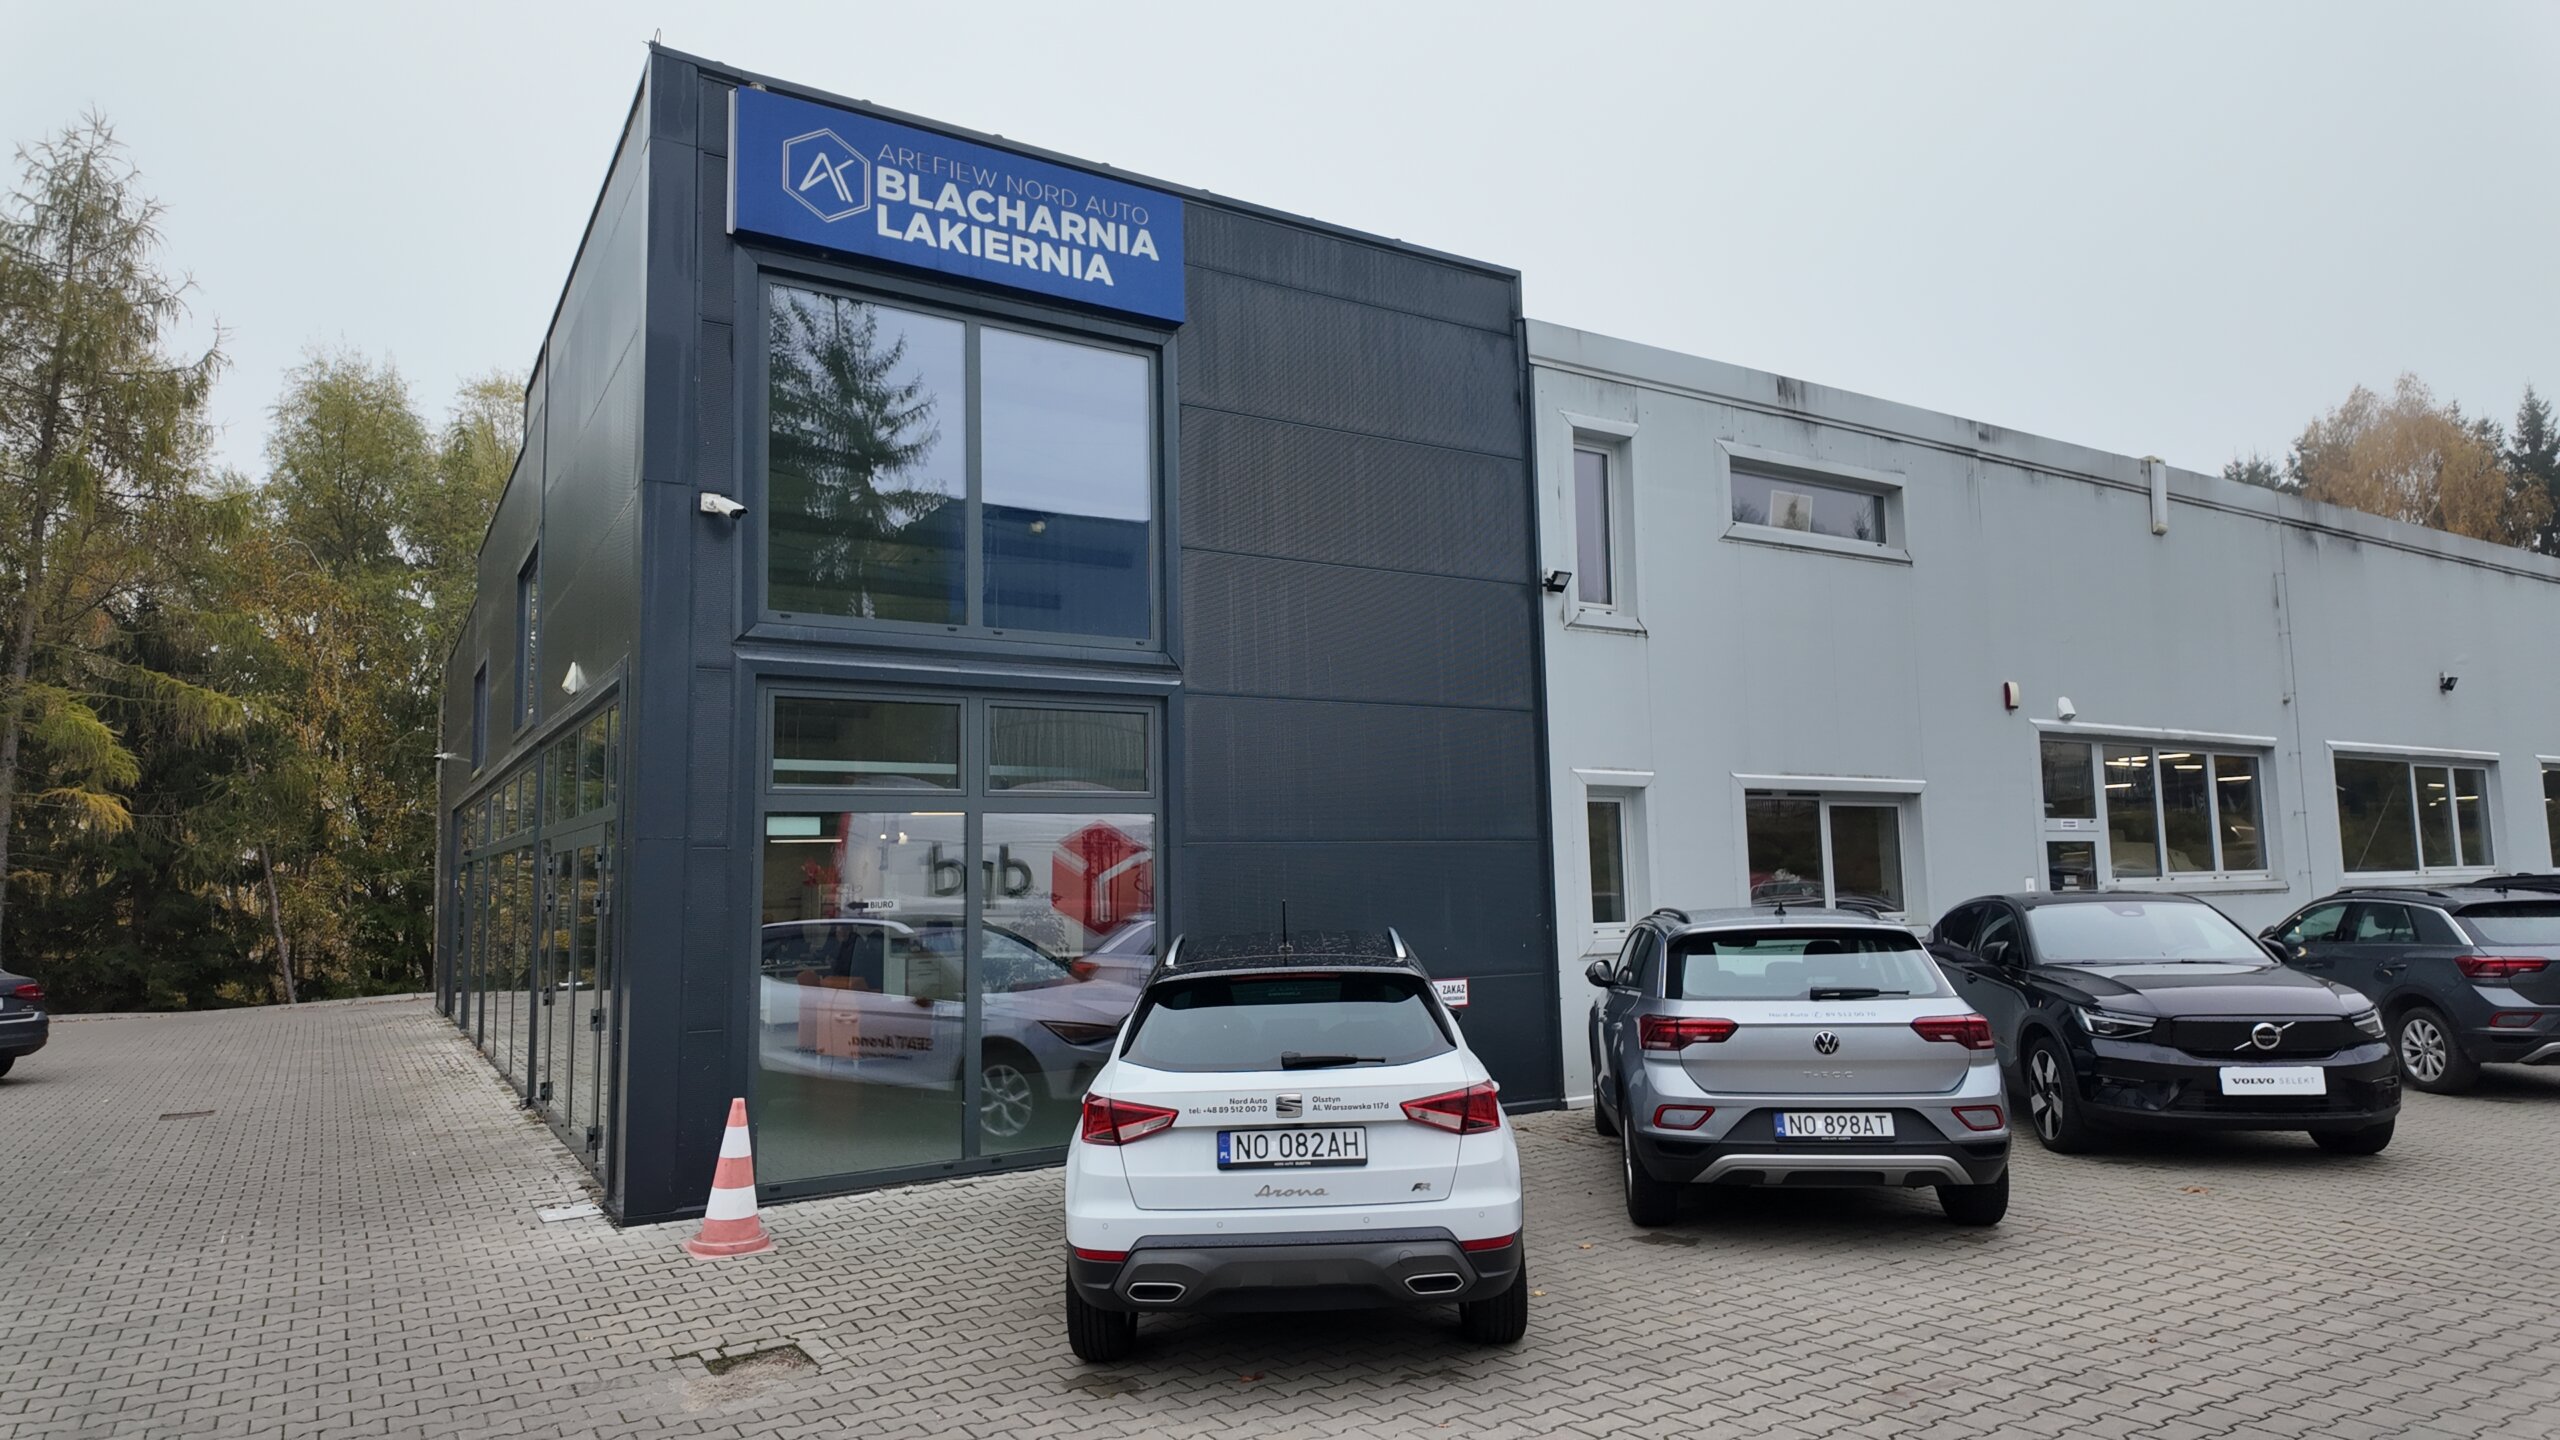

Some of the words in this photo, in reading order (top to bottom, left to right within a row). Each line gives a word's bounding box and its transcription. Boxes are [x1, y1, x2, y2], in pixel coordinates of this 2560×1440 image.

[877, 143, 997, 188] AREFIEW
[1006, 174, 1077, 208] NORD
[1085, 195, 1149, 225] AUTO
[877, 165, 1160, 261] BLACHARNIA
[877, 203, 1115, 286] LAKIERNIA
[870, 900, 894, 909] BIURO
[1442, 984, 1466, 995] ZAKAZ
[2279, 1077, 2315, 1085] SELEKT
[1312, 1095, 1341, 1104] Olsztyn
[1218, 1105, 1229, 1113] 89
[1230, 1105, 1244, 1113] 512
[1245, 1105, 1257, 1113] 00
[1257, 1104, 1268, 1113] 70
[1323, 1102, 1372, 1112] Warszawska
[1373, 1101, 1390, 1110] 117d
[1788, 1115, 1816, 1135] NO
[1823, 1115, 1887, 1135] 898AT
[1236, 1133, 1269, 1160] NO
[1279, 1130, 1359, 1158] 082AH
[1219, 1152, 1230, 1160] PL
[1254, 1184, 1330, 1198] Arona
